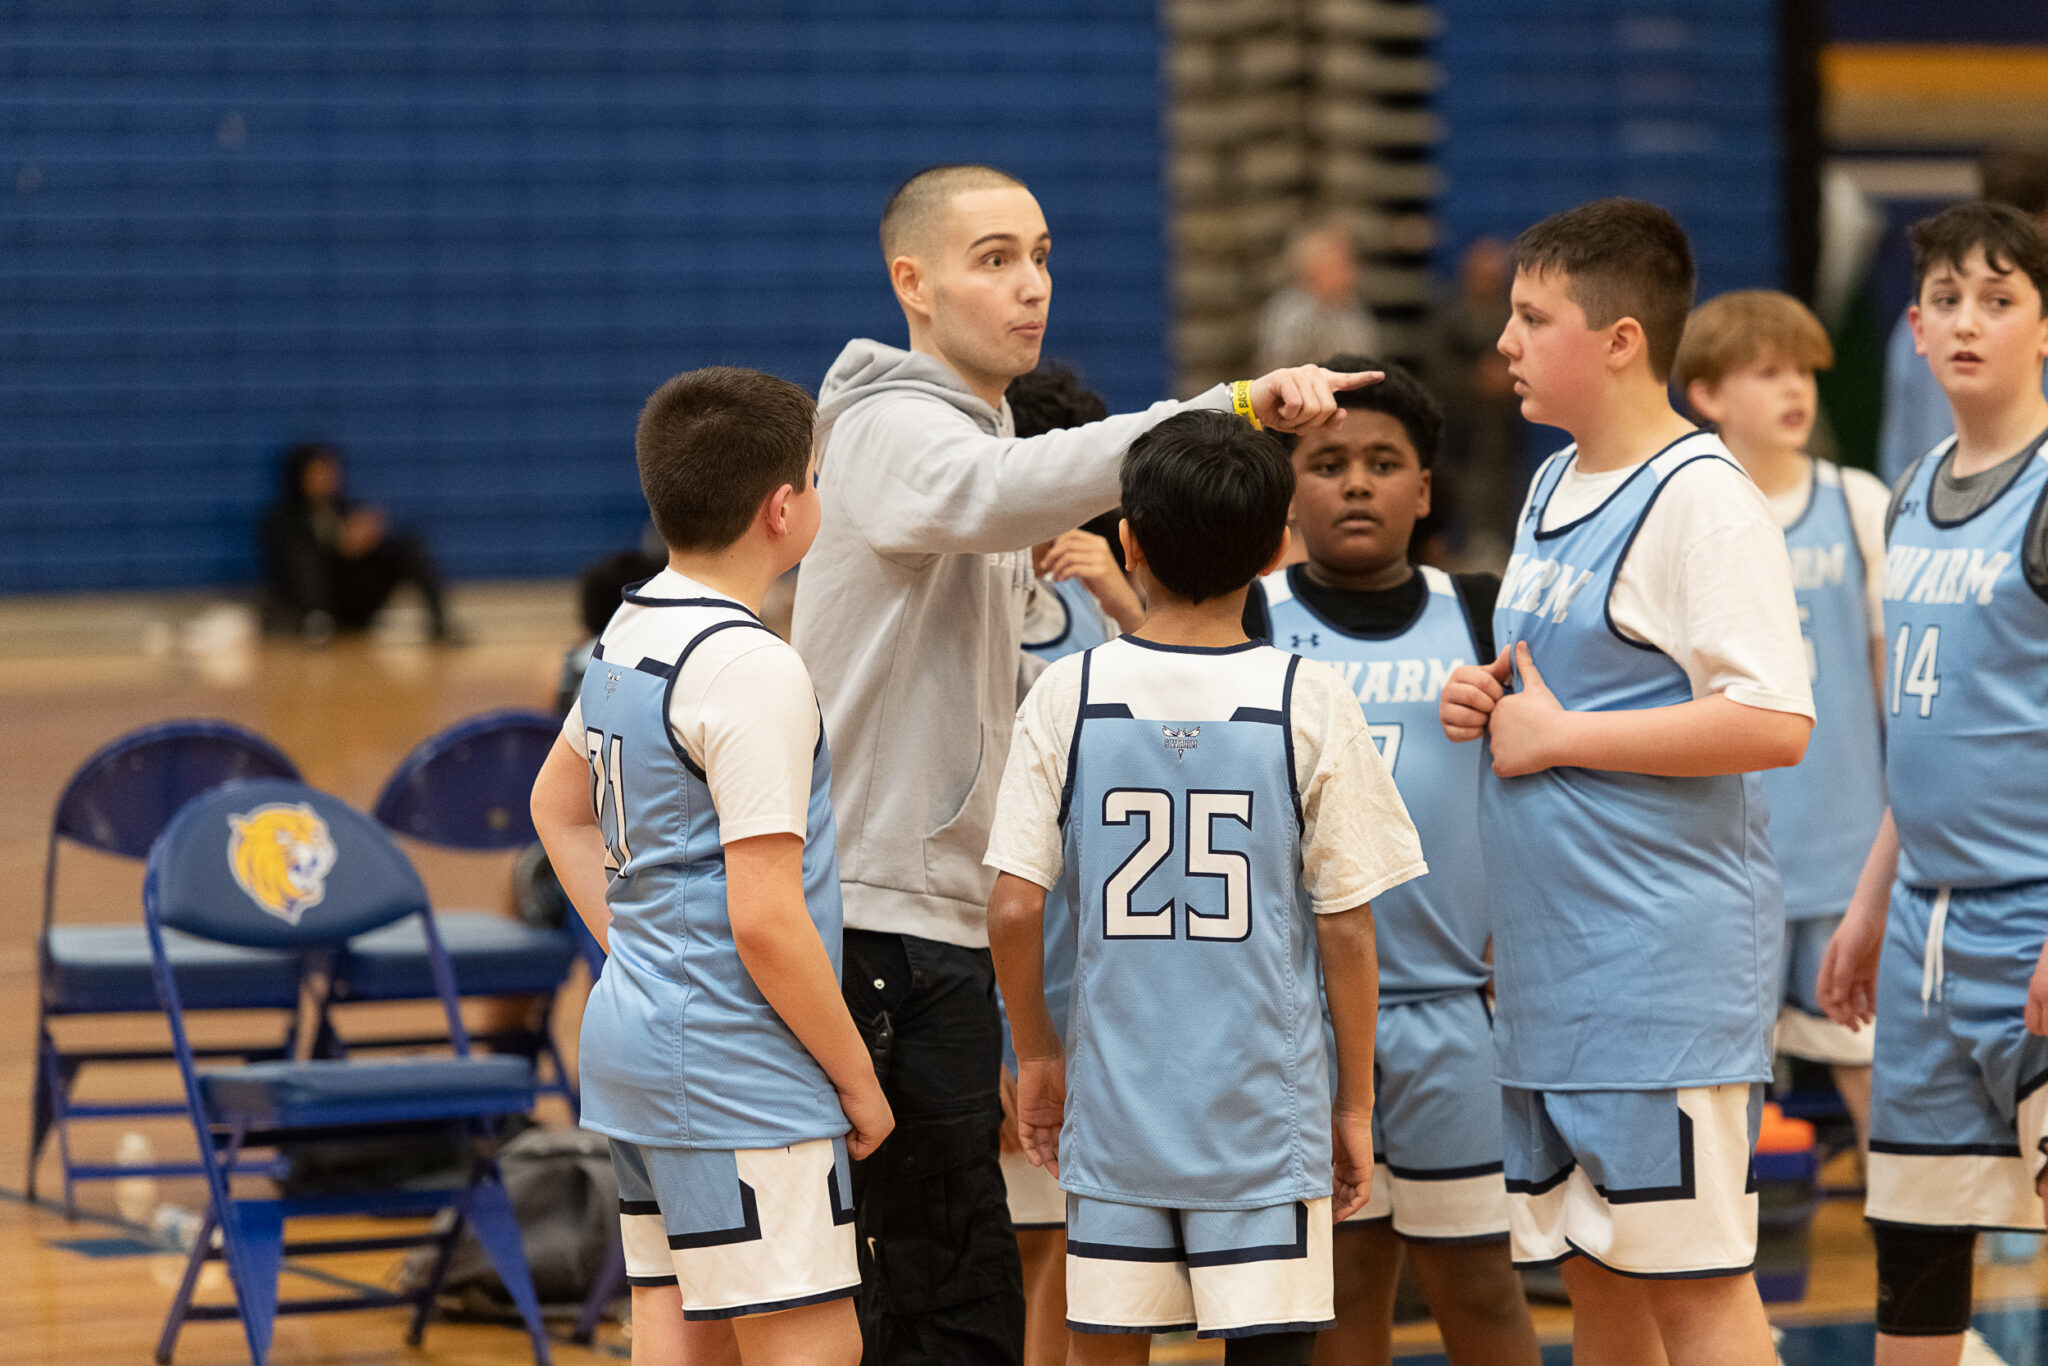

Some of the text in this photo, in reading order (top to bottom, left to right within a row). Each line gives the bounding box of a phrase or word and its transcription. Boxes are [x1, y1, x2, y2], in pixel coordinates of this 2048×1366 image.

[1329, 658, 1465, 704] WARM
[1891, 622, 1942, 719] 14
[1101, 786, 1254, 943] 25
